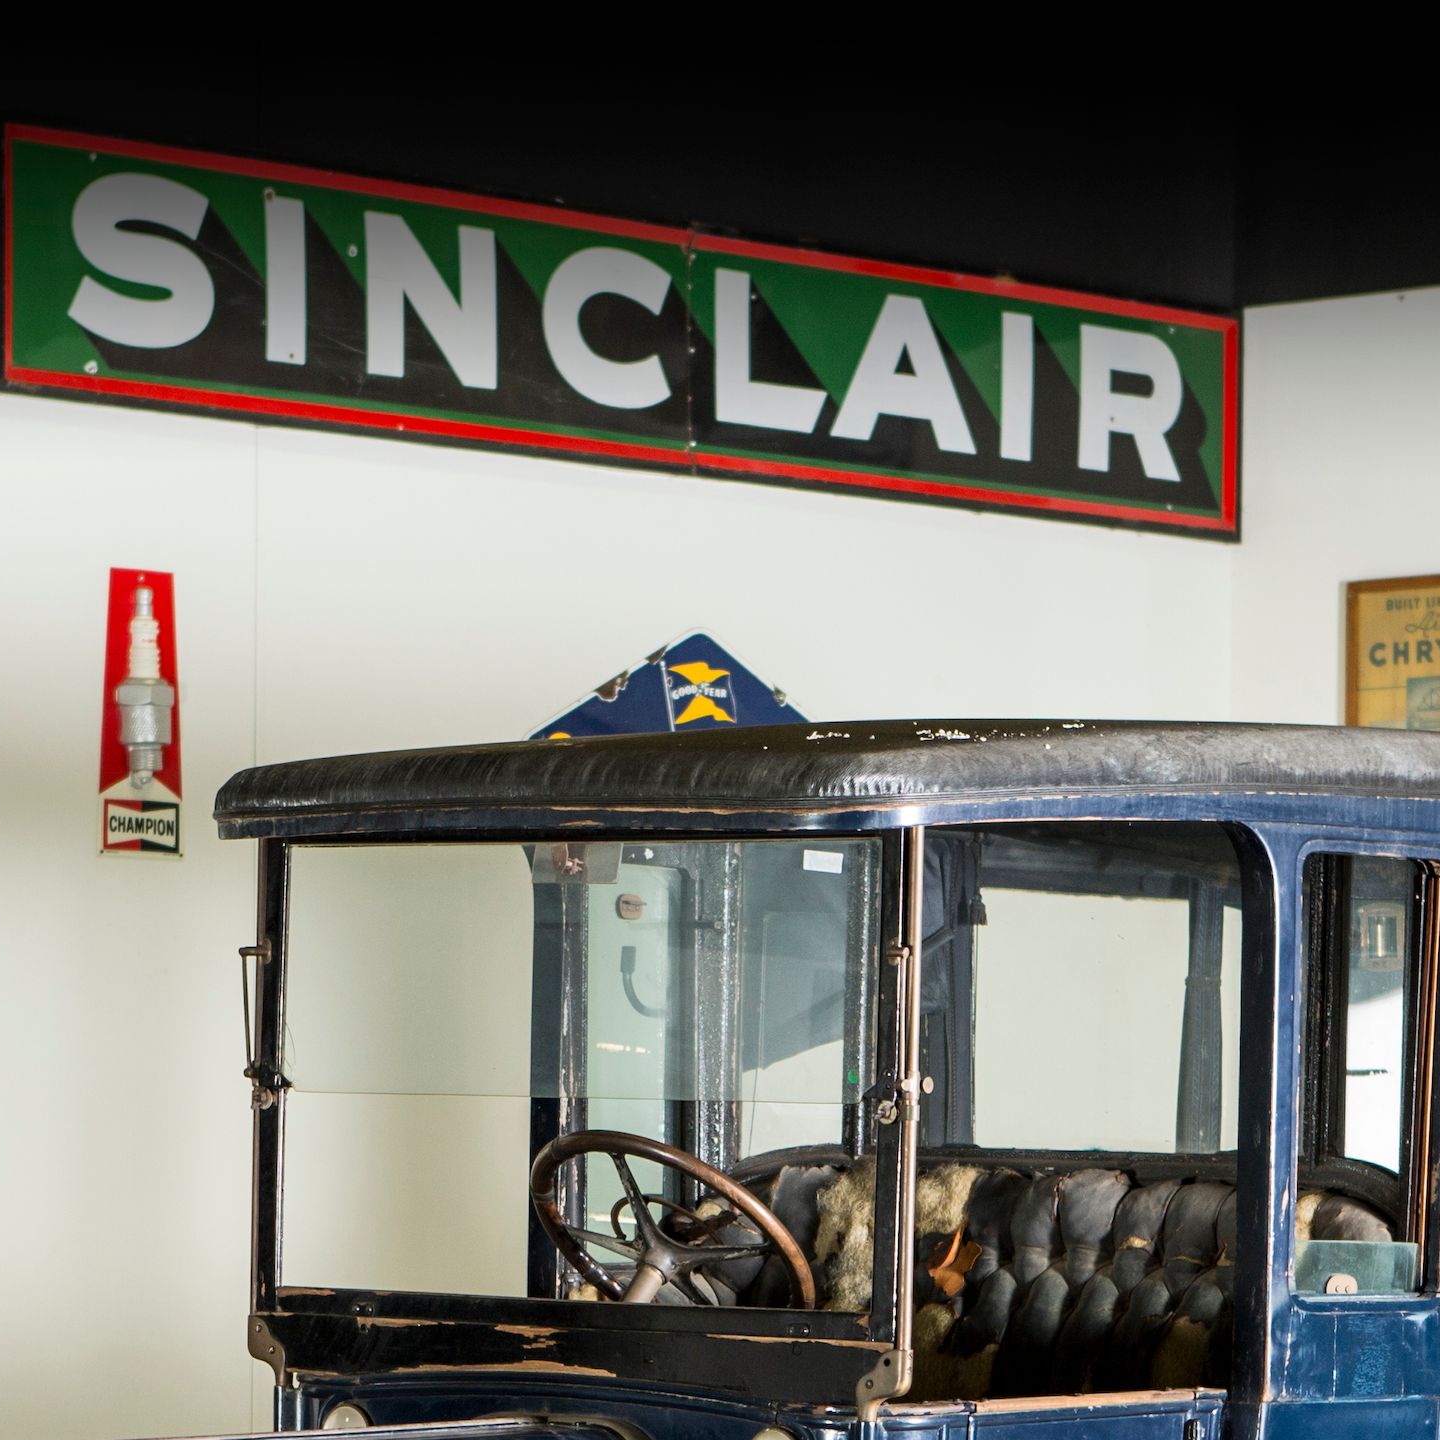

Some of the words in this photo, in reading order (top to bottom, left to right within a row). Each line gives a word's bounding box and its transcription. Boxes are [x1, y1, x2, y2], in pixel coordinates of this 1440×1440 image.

[67, 171, 1184, 482] SINCLAIR
[1386, 596, 1421, 612] BUILT
[109, 815, 175, 837] CHAMPION
